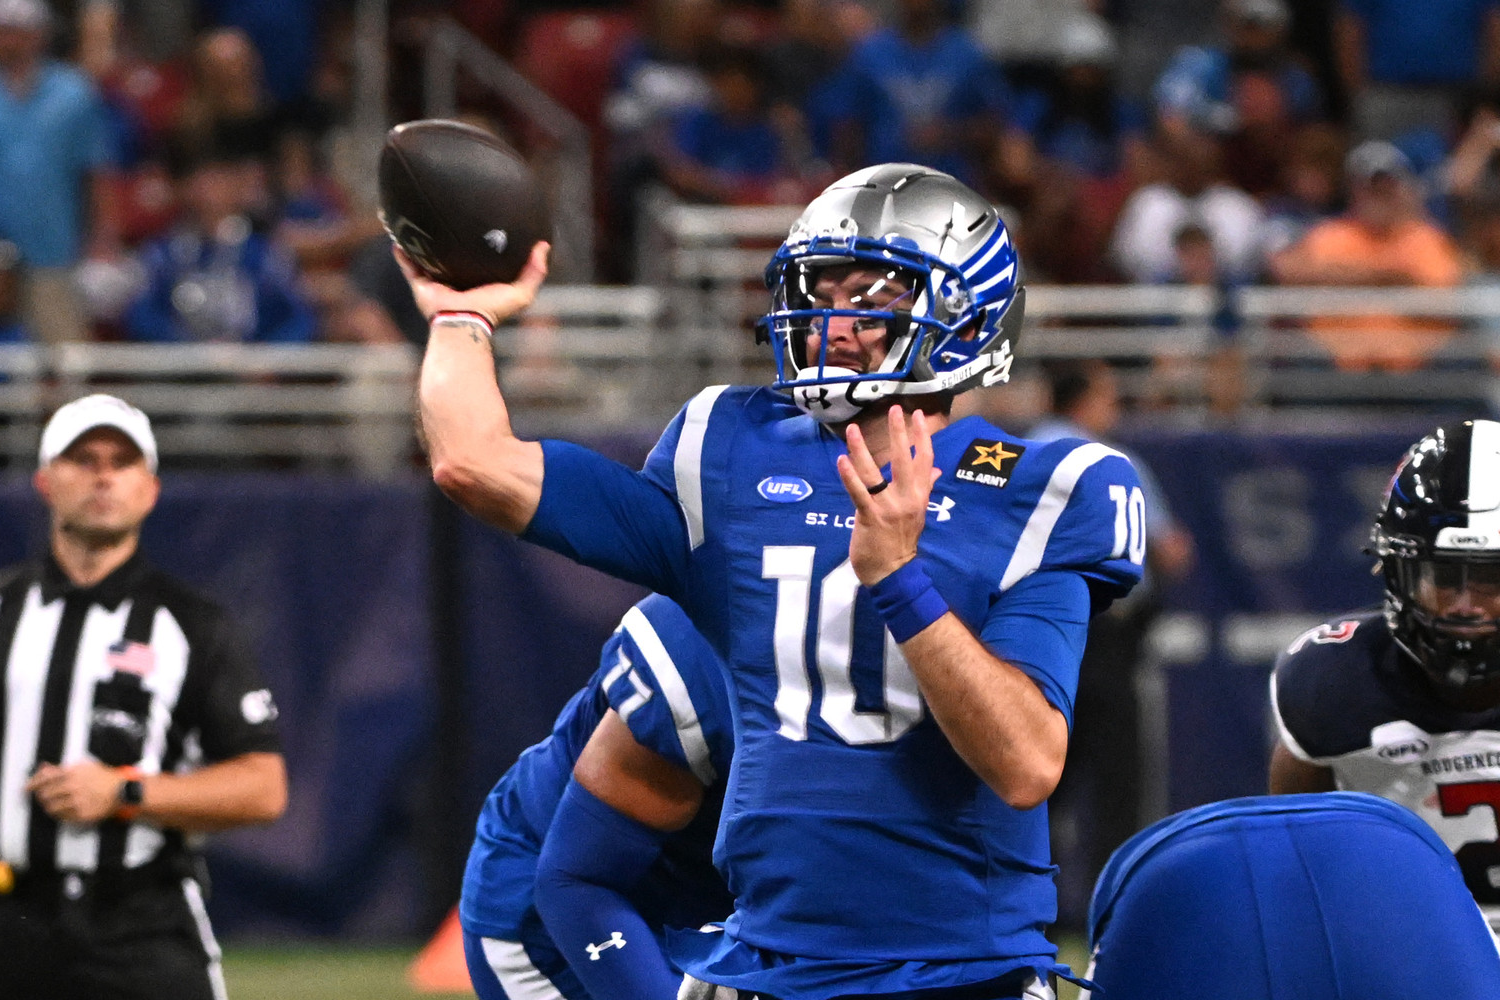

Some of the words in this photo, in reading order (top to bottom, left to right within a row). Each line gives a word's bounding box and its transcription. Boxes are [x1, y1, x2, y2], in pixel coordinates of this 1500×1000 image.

[975, 473, 1008, 487] ARMY
[1108, 484, 1146, 566] 10
[762, 545, 924, 745] 10
